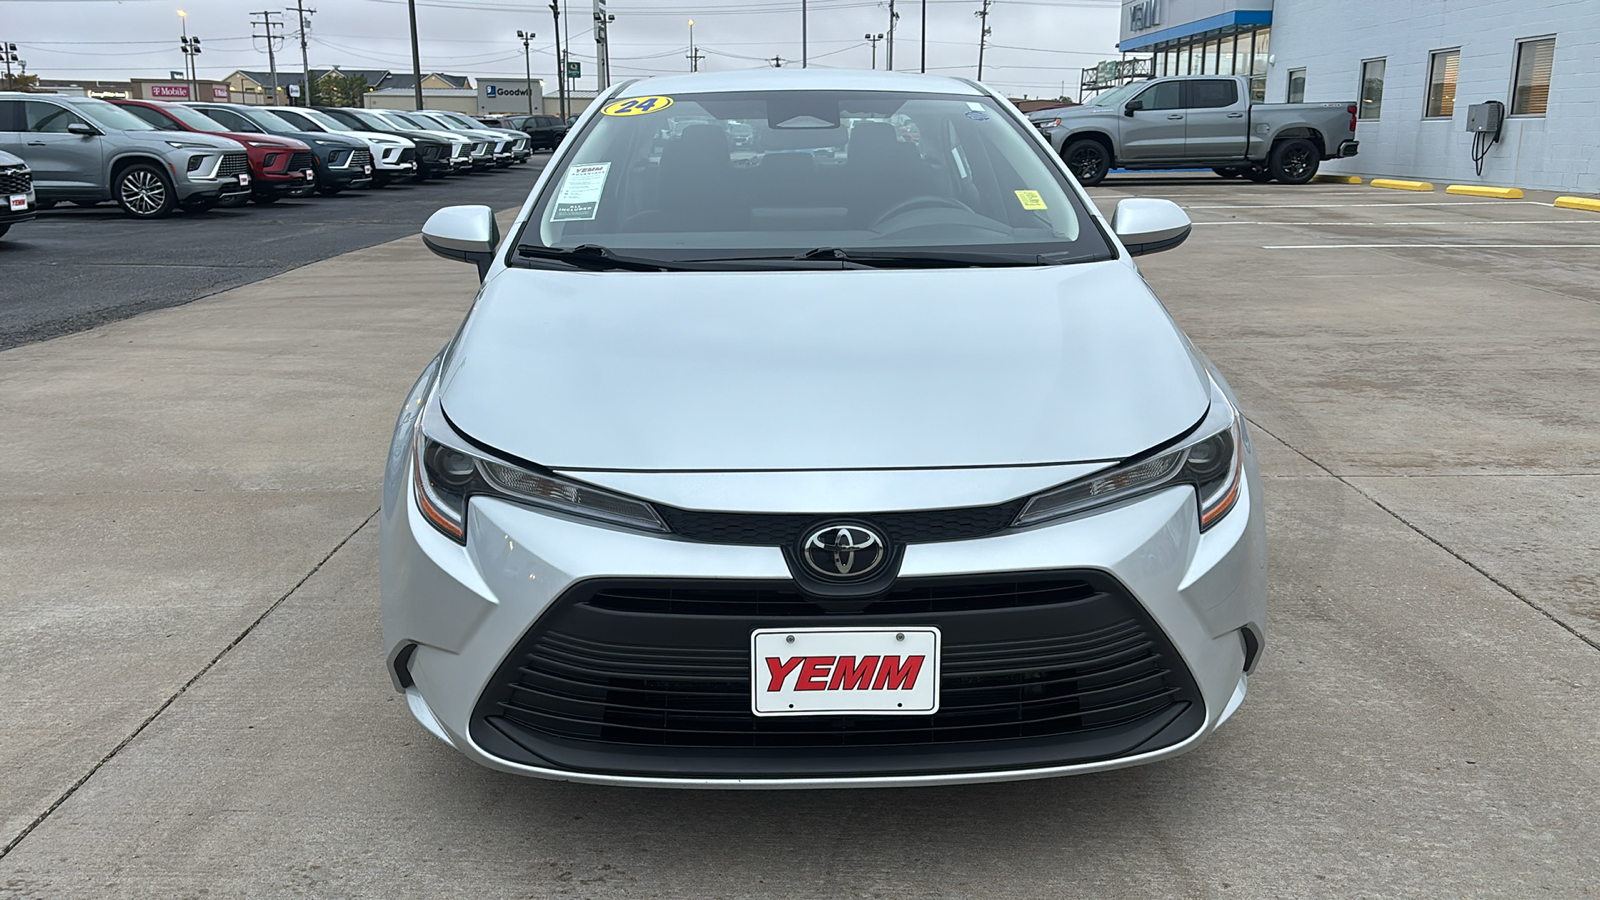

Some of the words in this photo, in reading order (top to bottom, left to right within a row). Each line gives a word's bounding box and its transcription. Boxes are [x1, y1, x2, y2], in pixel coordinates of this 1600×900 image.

[161, 87, 187, 96] Mobile
[497, 88, 532, 96] Goodwil
[614, 98, 658, 114] 24
[765, 655, 926, 692] YEMM
